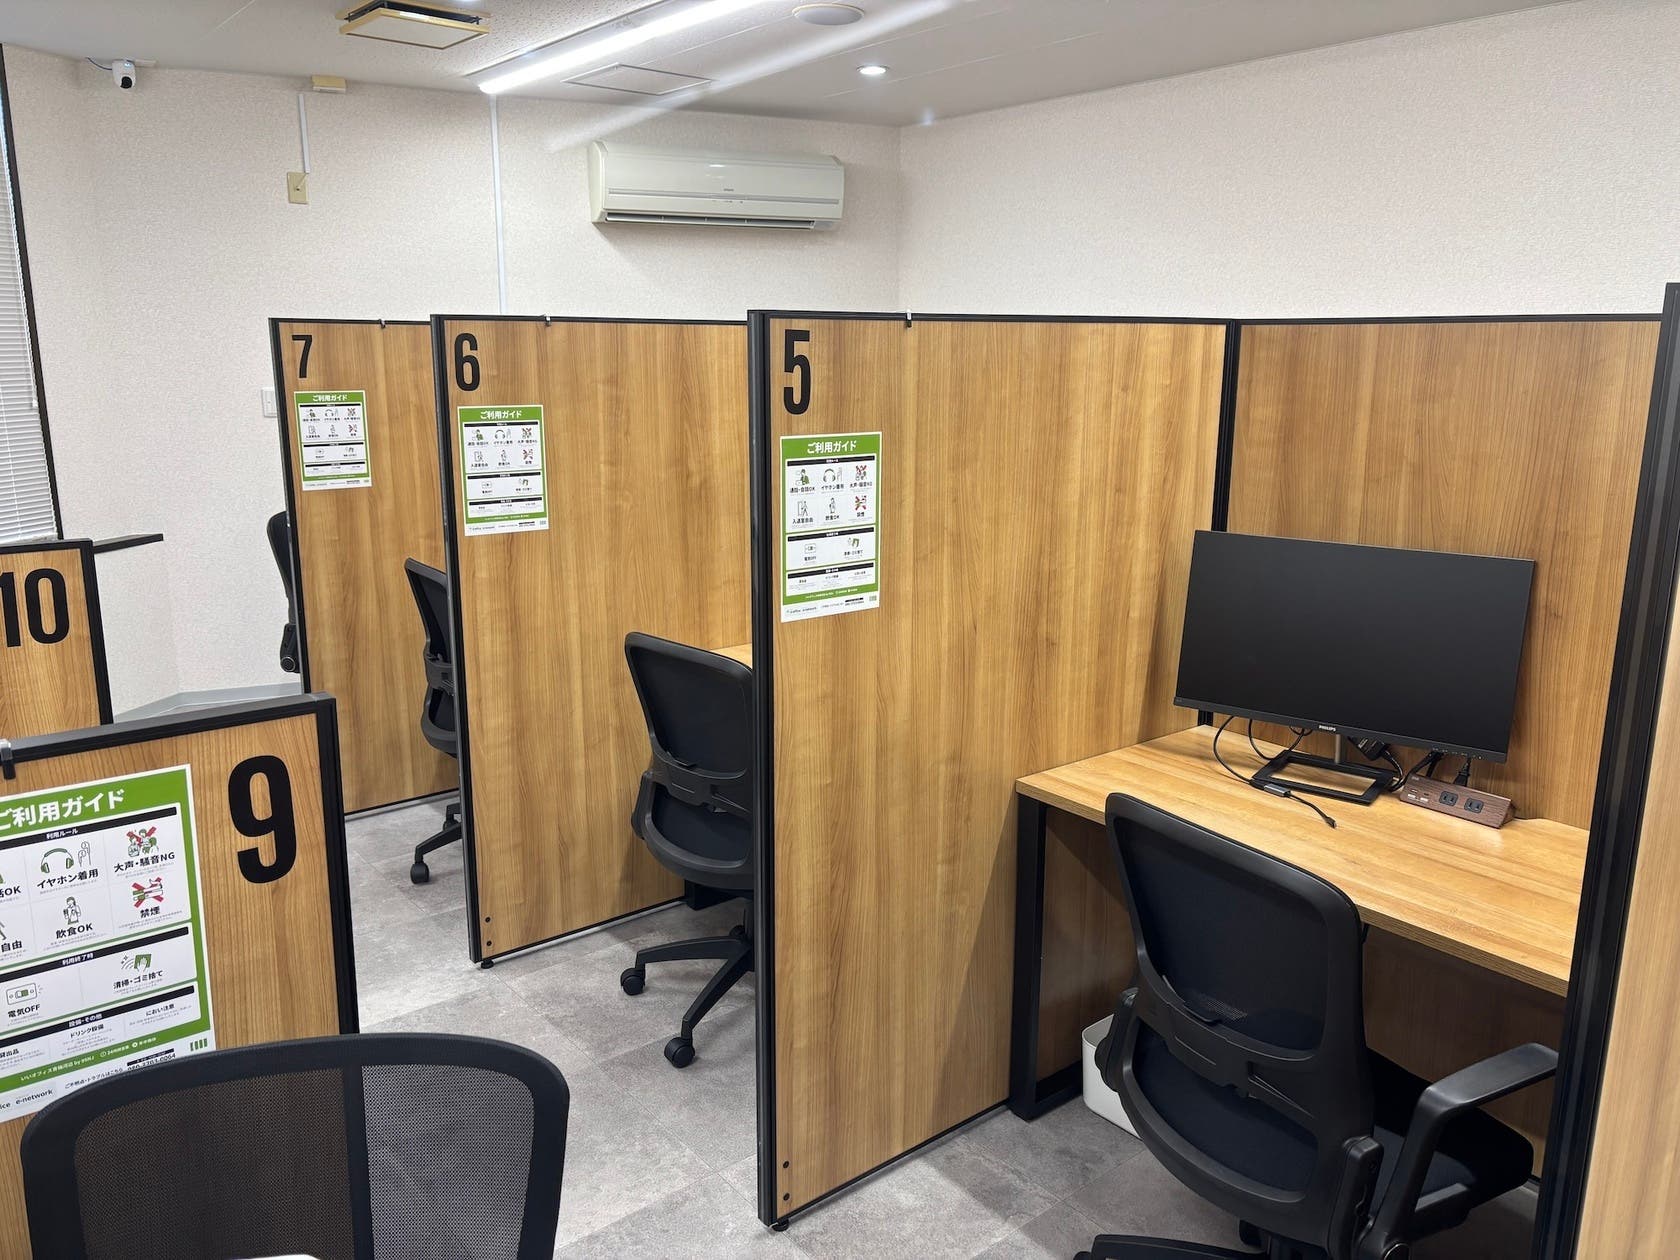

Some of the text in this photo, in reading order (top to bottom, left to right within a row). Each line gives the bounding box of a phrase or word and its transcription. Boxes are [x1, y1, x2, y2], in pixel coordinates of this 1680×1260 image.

[291, 334, 313, 379] 7
[454, 333, 480, 392] 6
[784, 329, 811, 415] 5
[480, 410, 522, 420] ご利用ガイド
[807, 440, 857, 454] ご利用ガイド
[0, 568, 70, 647] 10
[227, 755, 297, 884] 9
[113, 851, 176, 873] 大声・騒音NG
[36, 868, 99, 889] イヤホン着用
[140, 906, 161, 918] 禁煙
[55, 922, 93, 939] 飲食OK
[7, 1003, 41, 1018] 電気OFF
[15, 1089, 53, 1104] e-network
